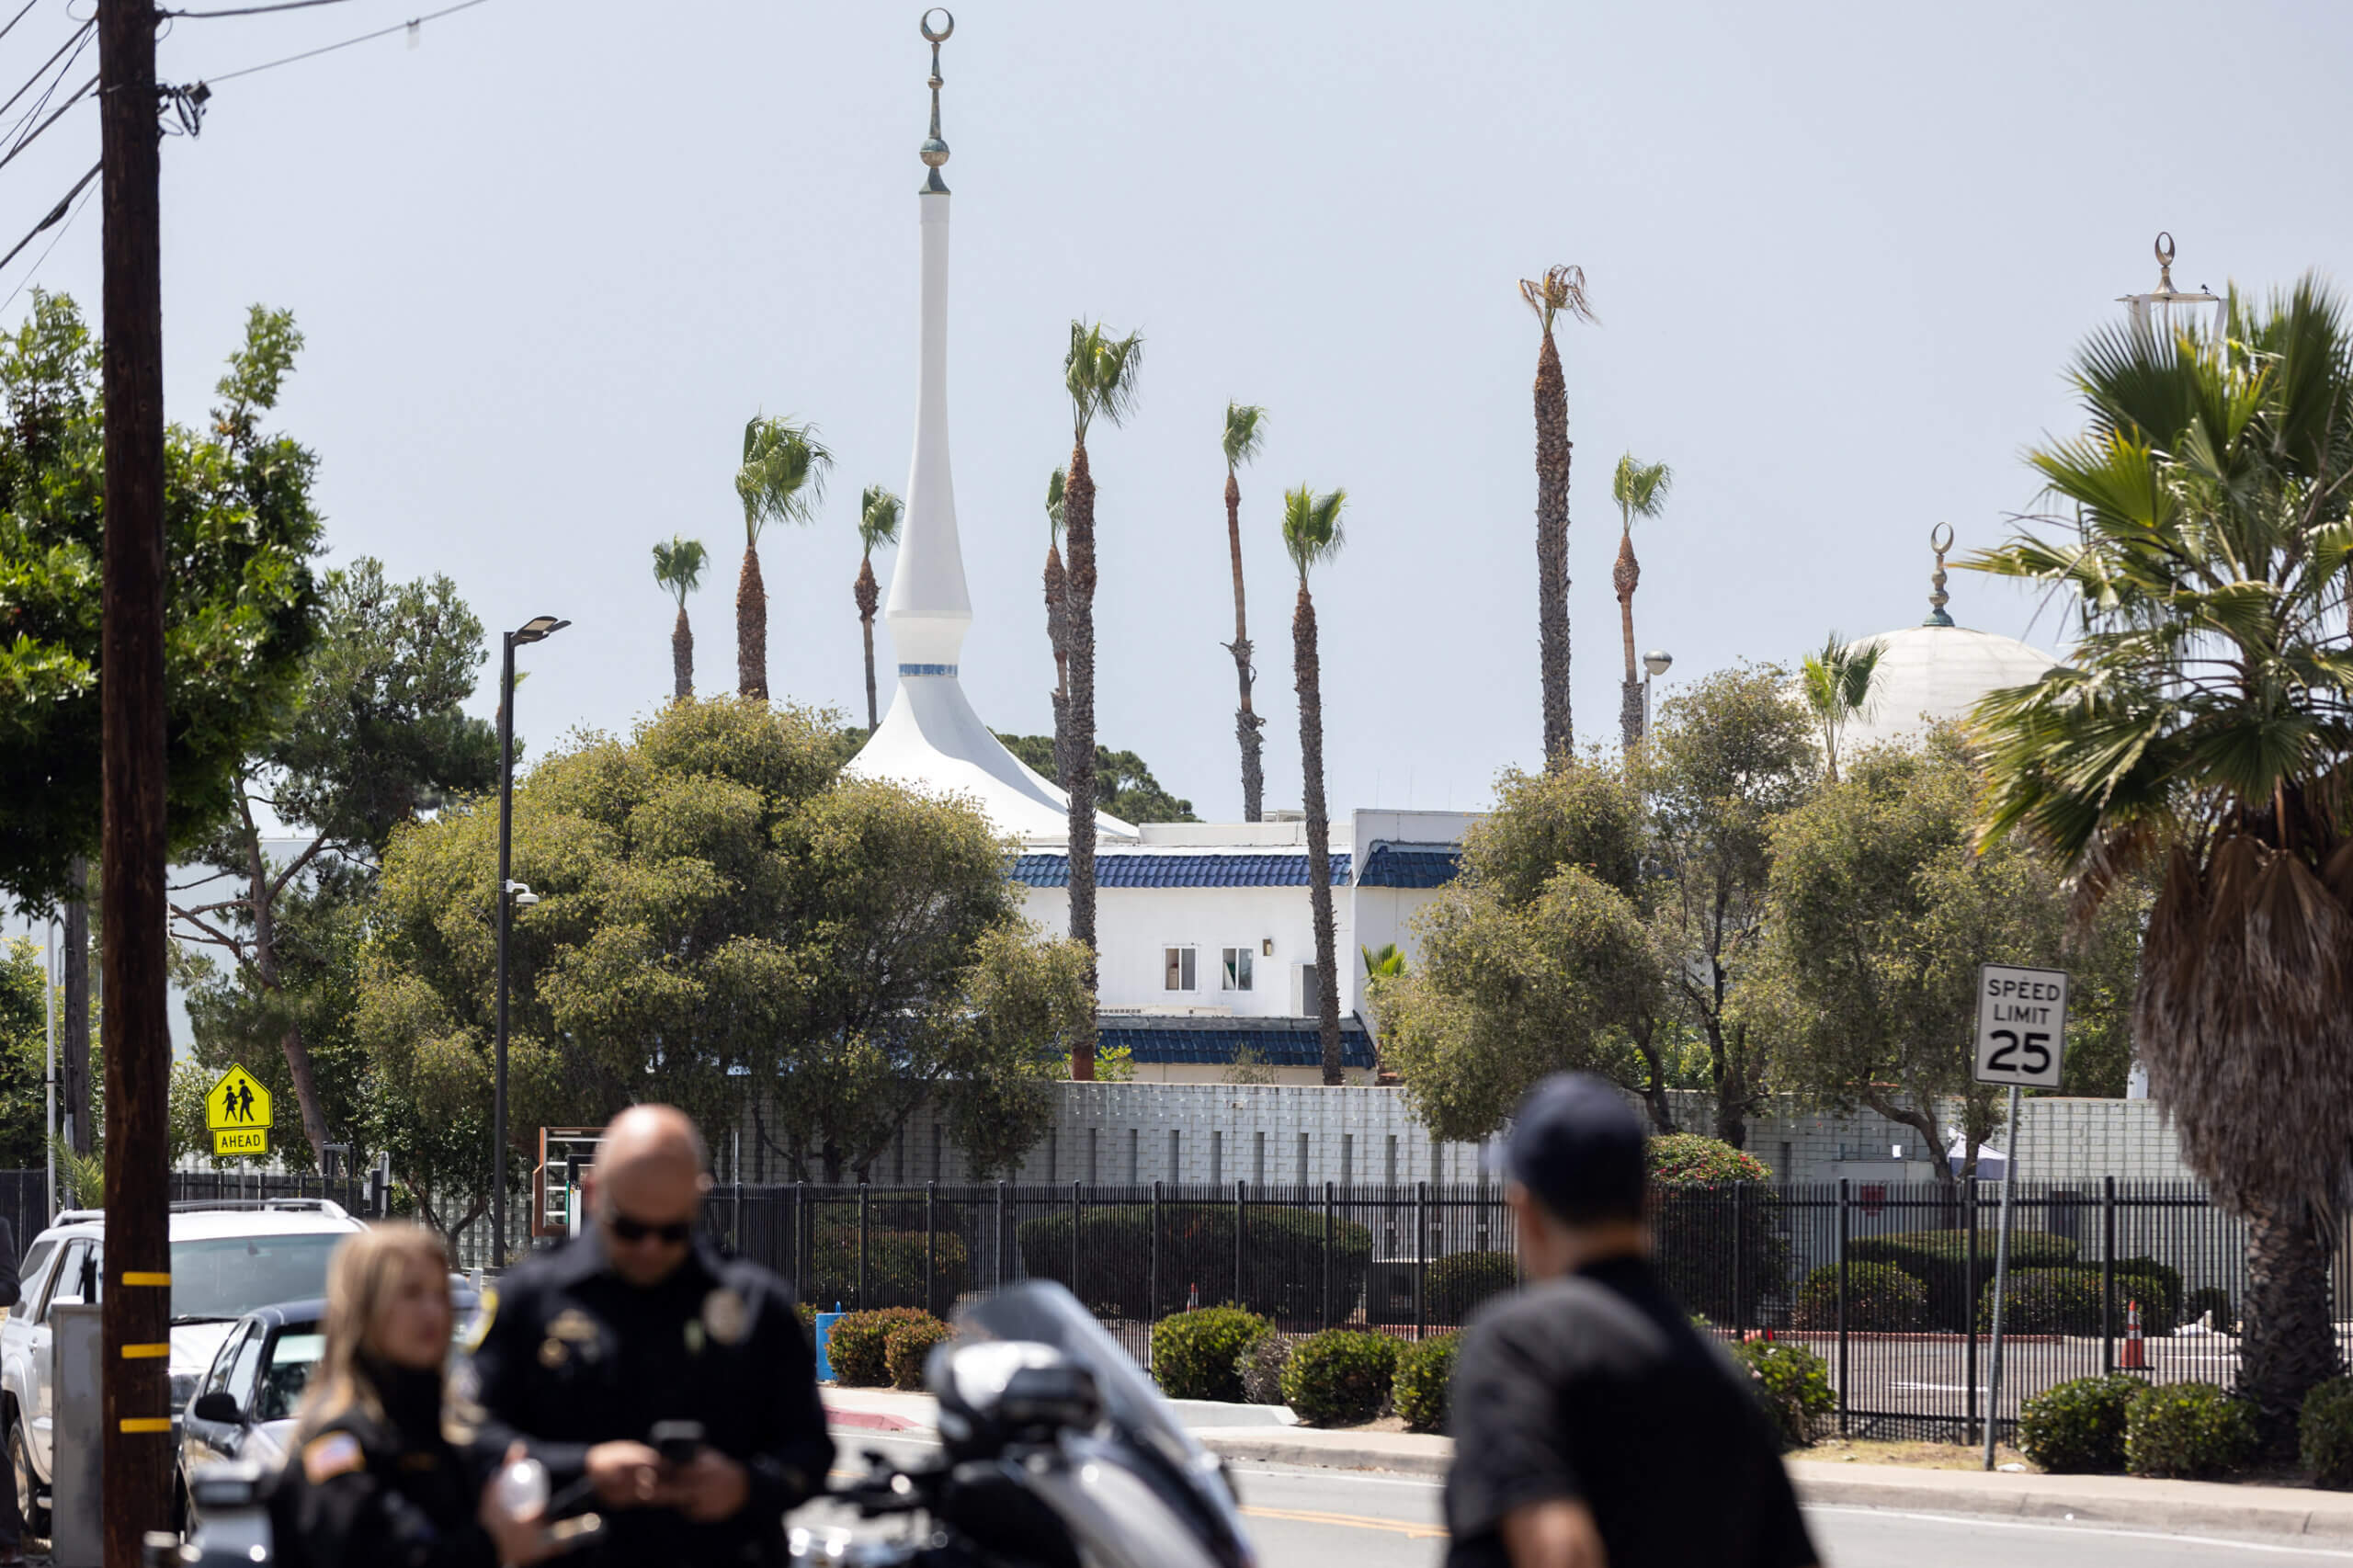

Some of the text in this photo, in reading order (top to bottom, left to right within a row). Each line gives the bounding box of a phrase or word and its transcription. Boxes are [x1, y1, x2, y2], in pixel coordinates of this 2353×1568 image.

[1987, 979, 2061, 1001] SPEED
[1994, 1004, 2051, 1025] LIMIT
[1987, 1029, 2052, 1074] 25
[221, 1134, 261, 1148] AHEAD
